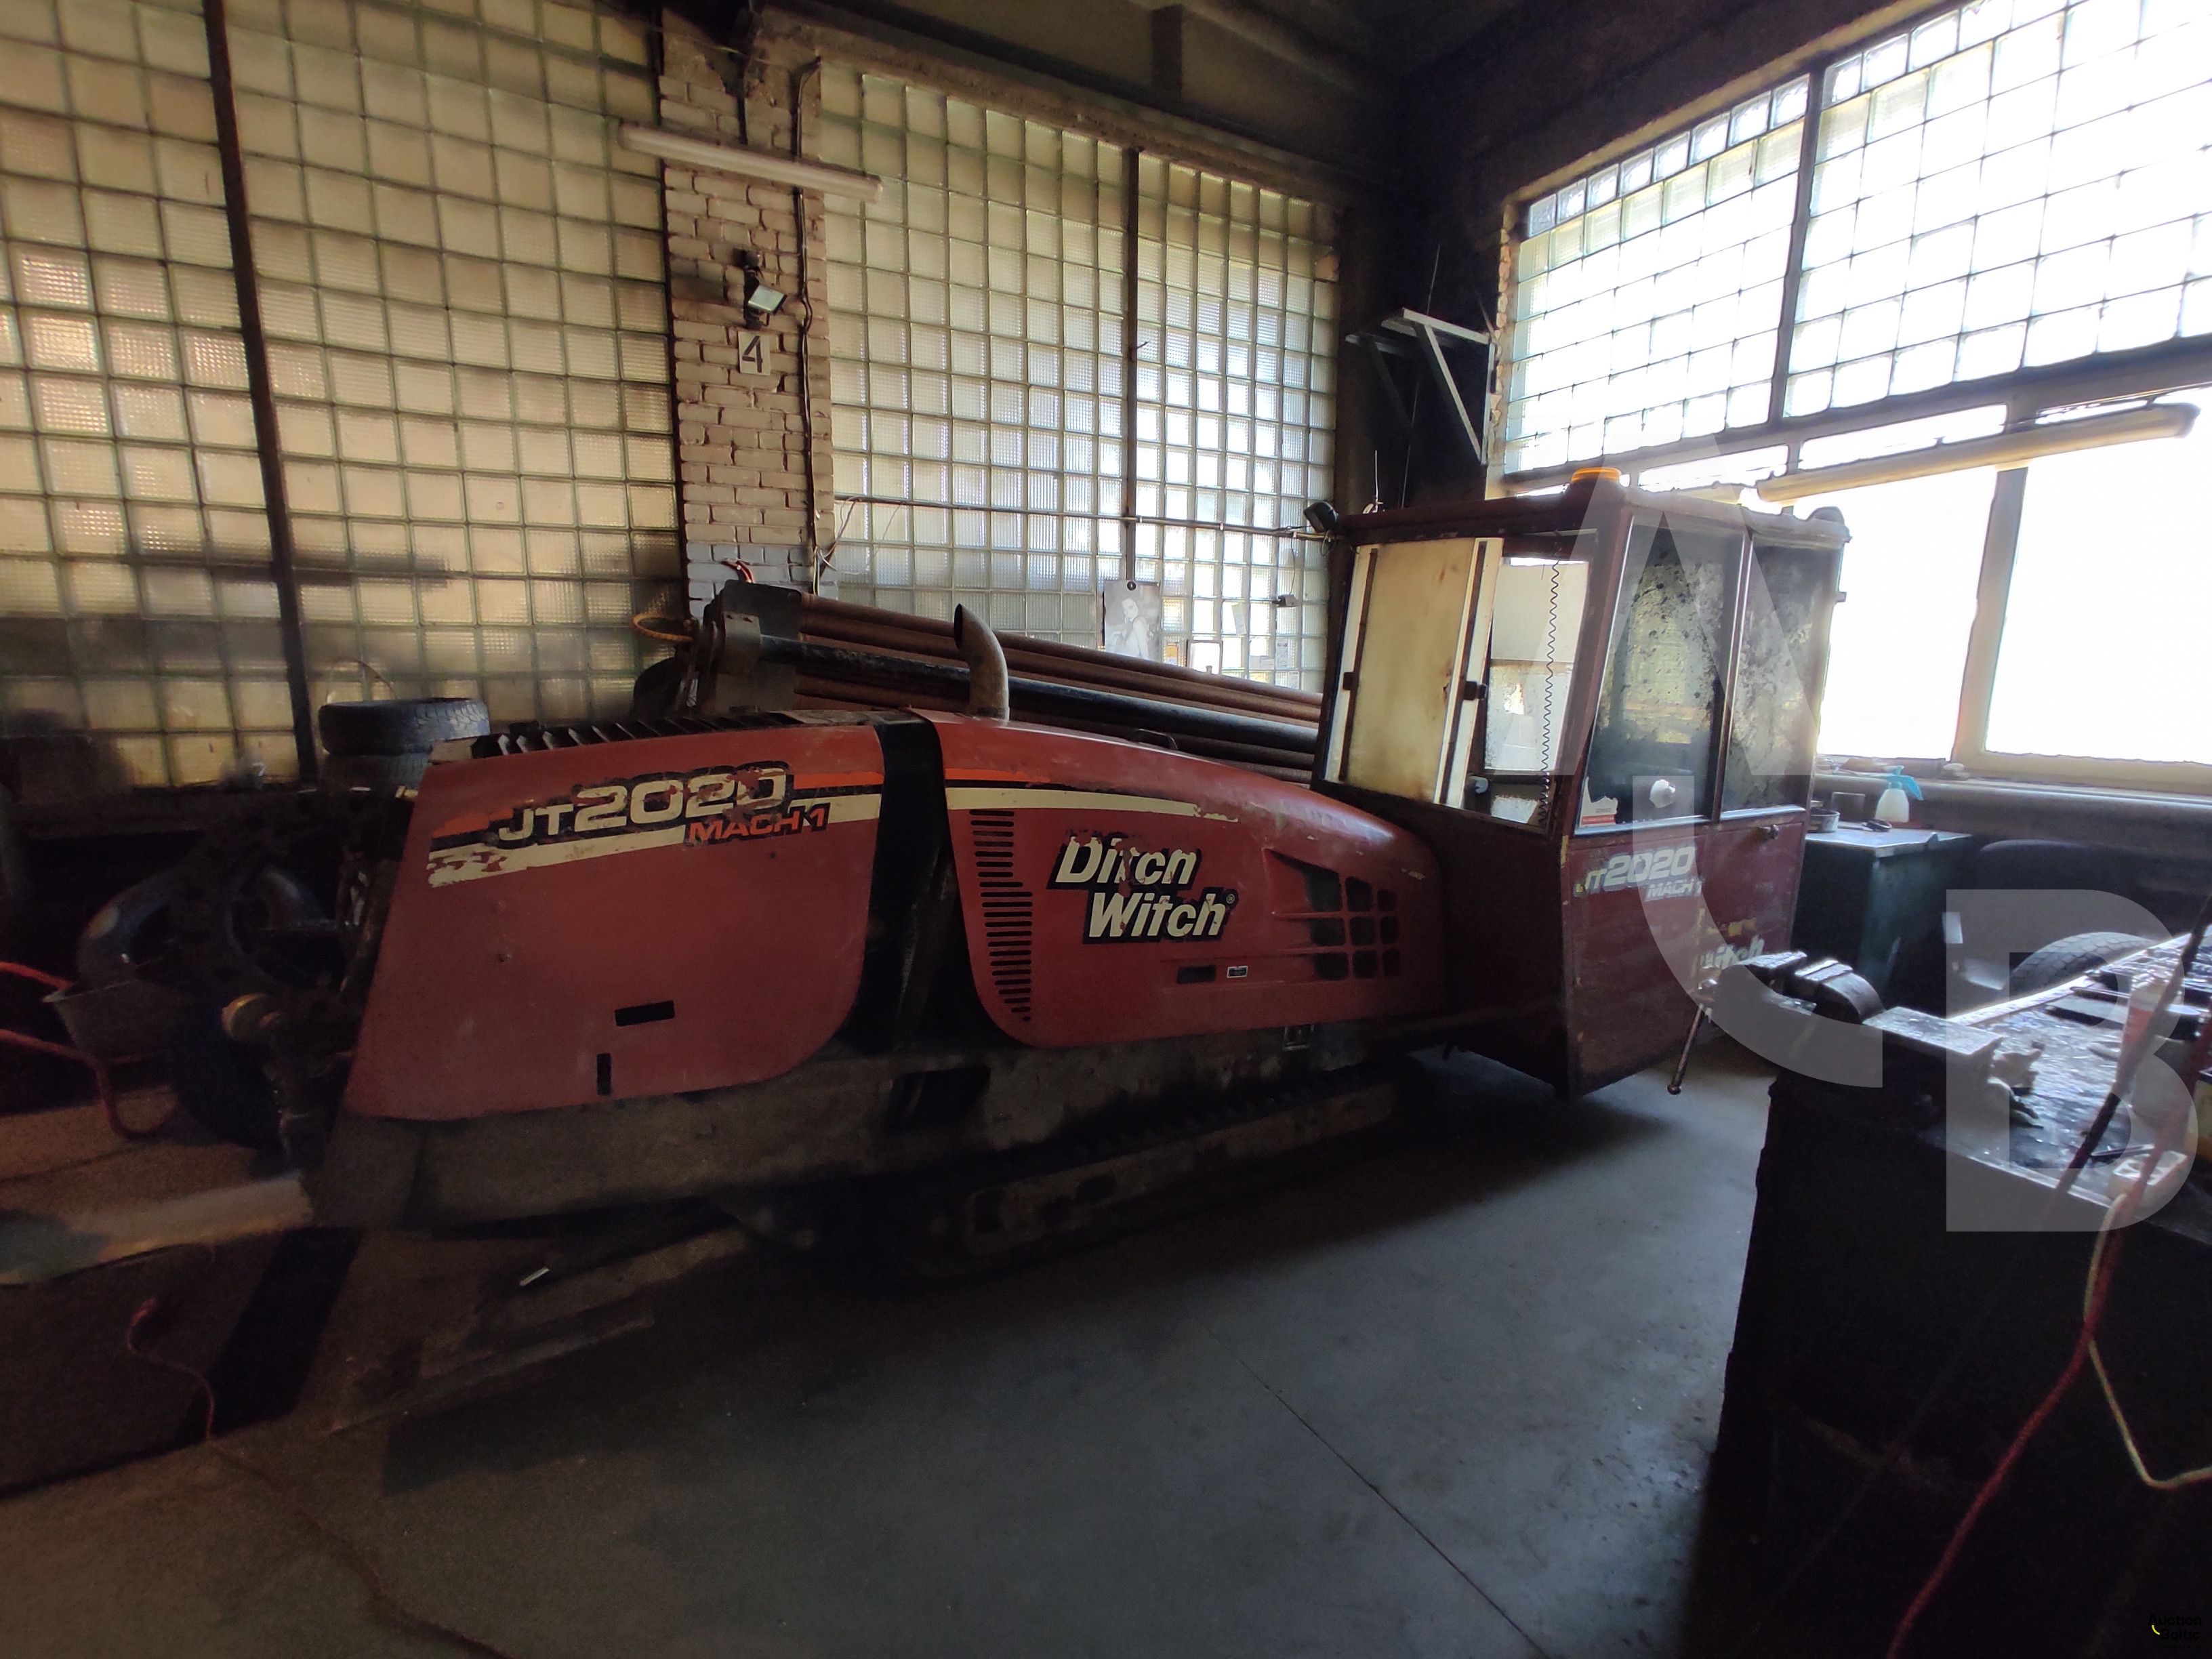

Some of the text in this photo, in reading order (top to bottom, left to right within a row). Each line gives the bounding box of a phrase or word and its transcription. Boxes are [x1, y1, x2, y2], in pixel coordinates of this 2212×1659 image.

[741, 335, 763, 373] 4
[498, 766, 786, 842] JT2020
[688, 807, 825, 842] MACH 1
[1088, 892, 1227, 938] Witch
